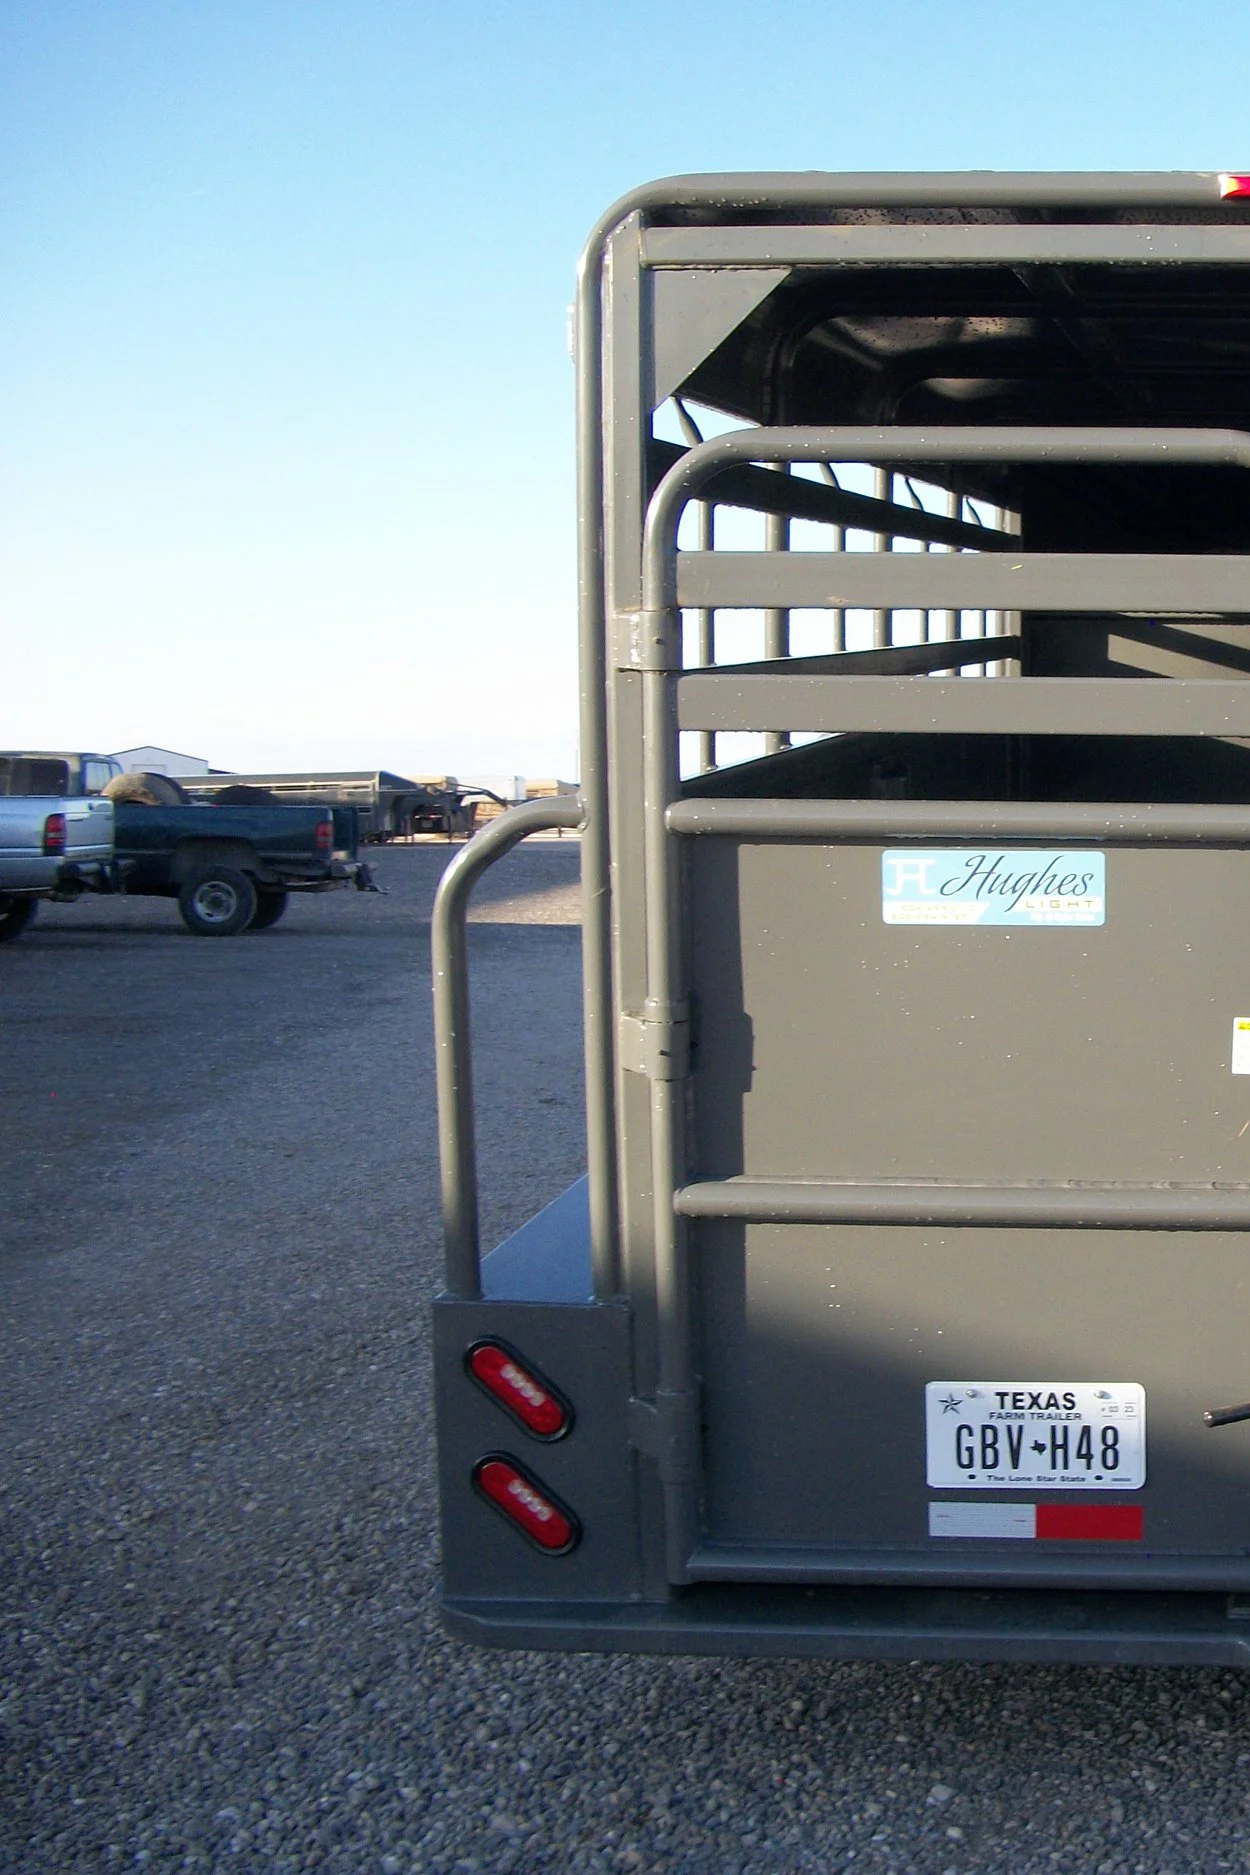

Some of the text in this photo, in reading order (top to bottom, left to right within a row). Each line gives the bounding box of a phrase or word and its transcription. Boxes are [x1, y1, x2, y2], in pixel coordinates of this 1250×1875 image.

[940, 854, 1094, 912] Hughes
[1026, 900, 1094, 909] LIGHT
[995, 1391, 1076, 1411] TEXAS
[989, 1412, 1082, 1421] FARM TRAILER
[955, 1424, 1119, 1471] GBV H48
[987, 1474, 1005, 1482] The
[1060, 1475, 1086, 1483] State
